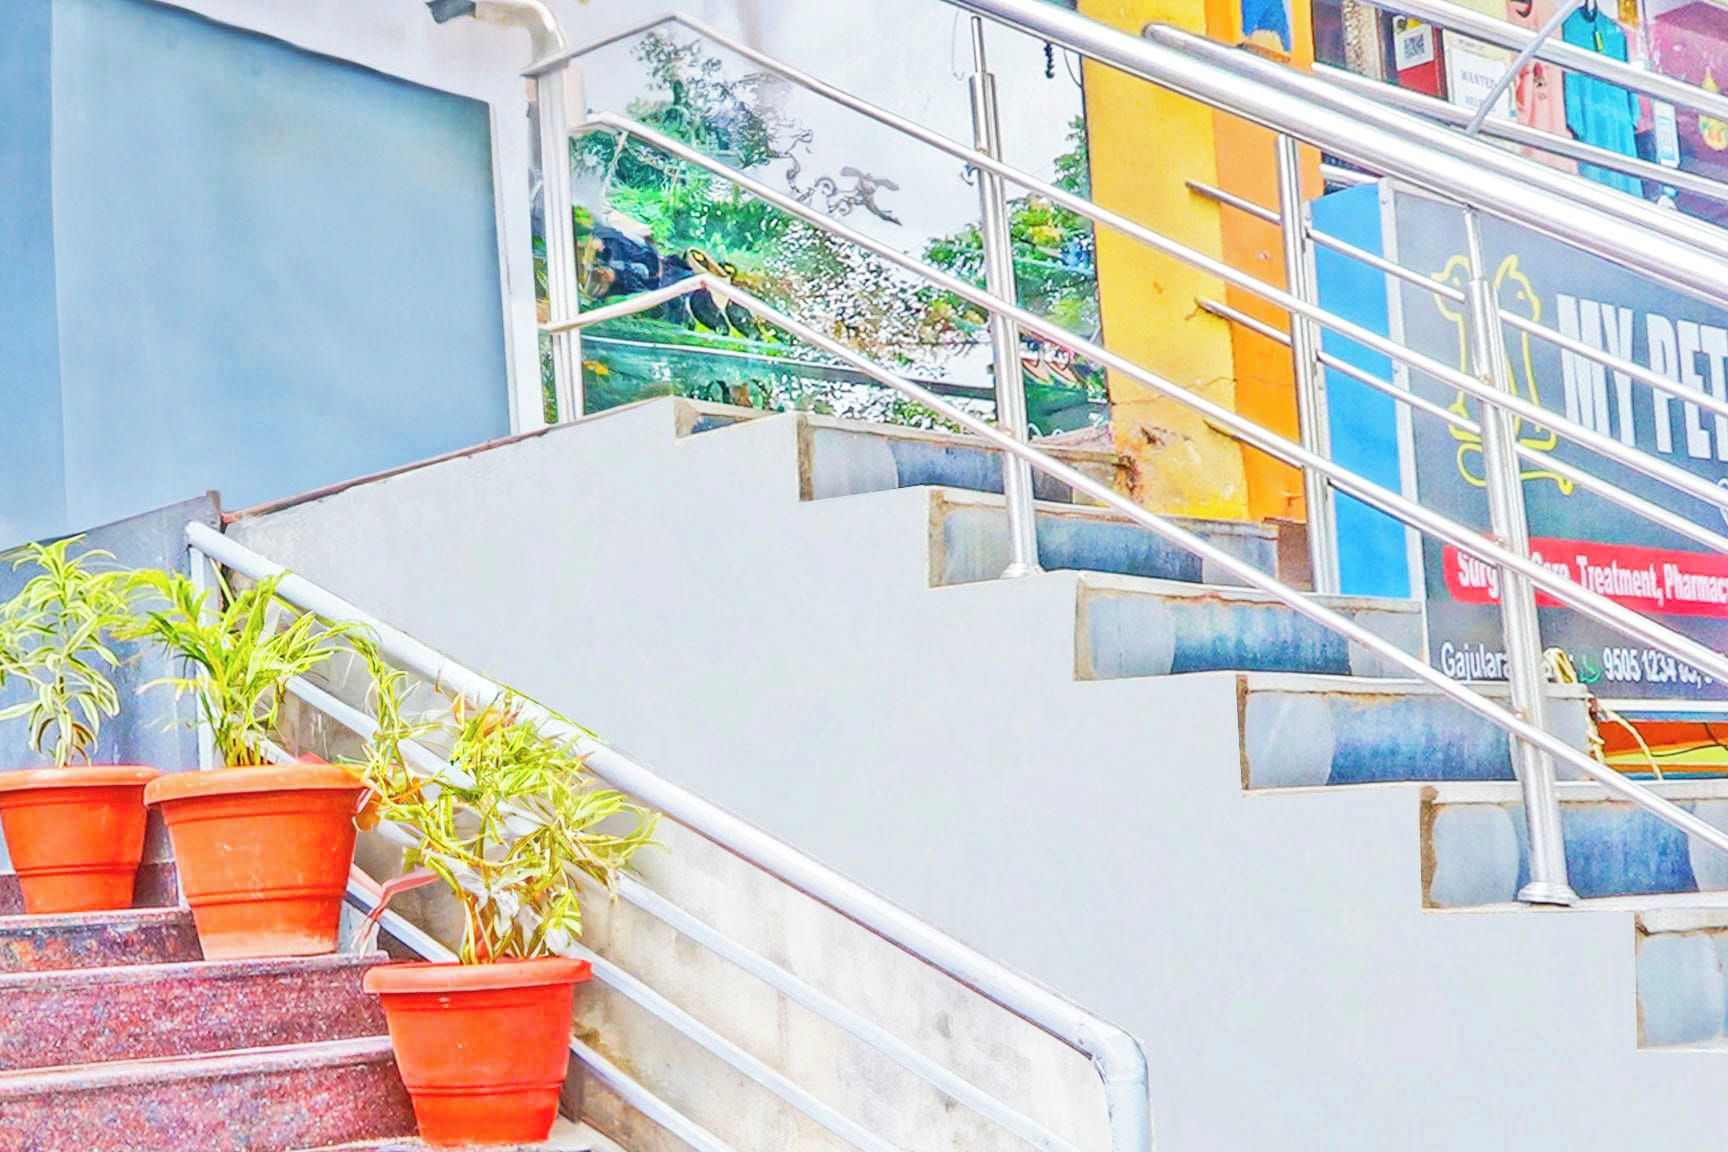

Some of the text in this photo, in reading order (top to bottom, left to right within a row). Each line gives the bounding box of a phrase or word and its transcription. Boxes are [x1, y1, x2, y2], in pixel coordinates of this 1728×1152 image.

[1556, 293, 1636, 447] MY
[1576, 555, 1664, 608] Treatment,
[1663, 563, 1728, 603] Pharmac
[1603, 648, 1640, 682] 9505
